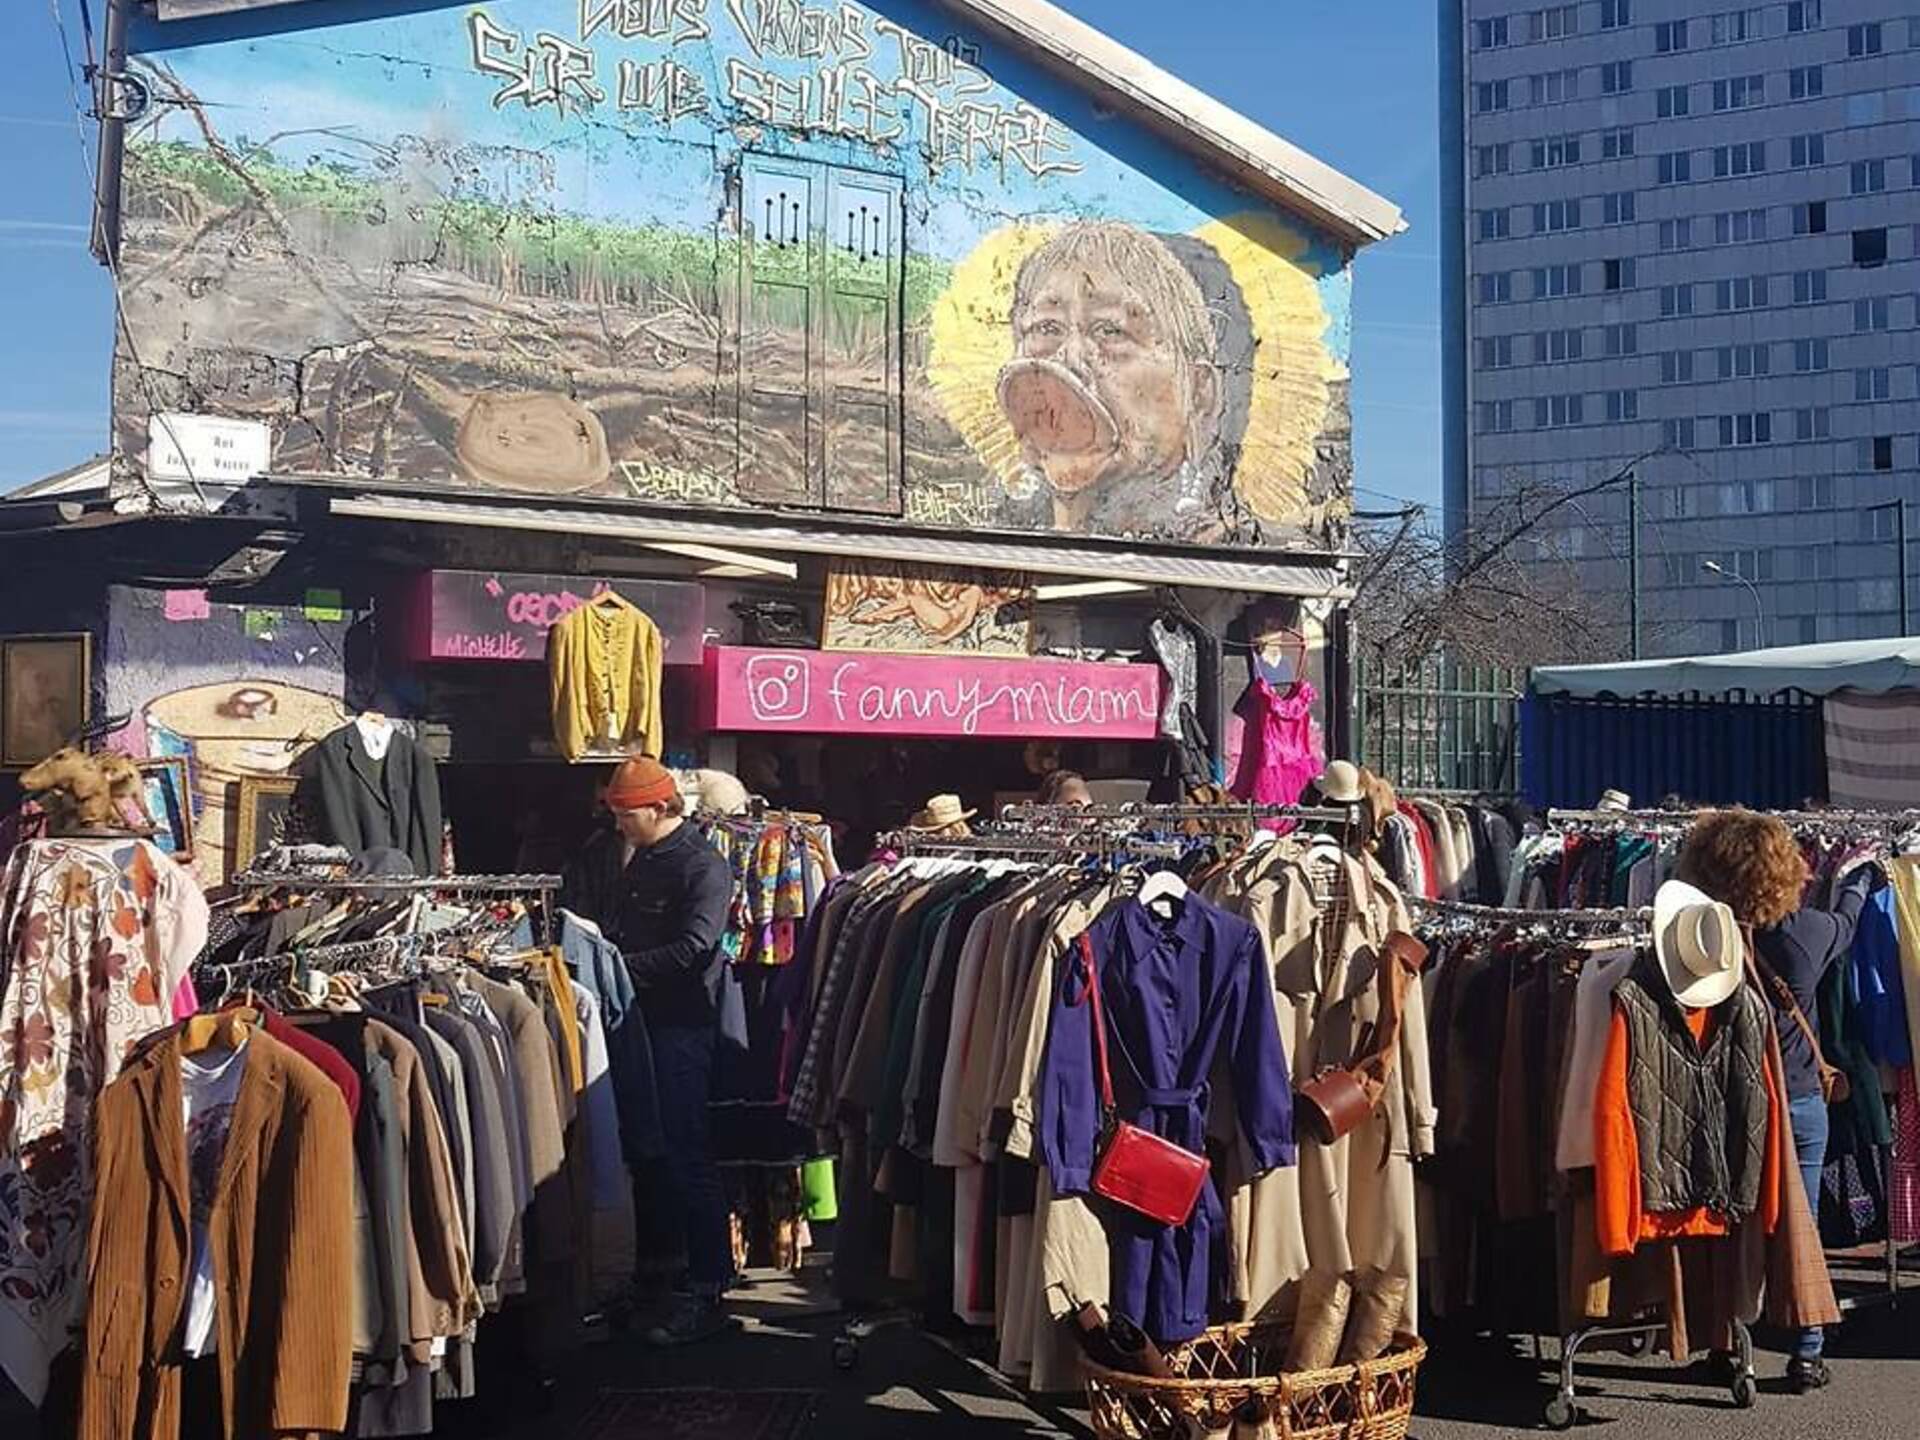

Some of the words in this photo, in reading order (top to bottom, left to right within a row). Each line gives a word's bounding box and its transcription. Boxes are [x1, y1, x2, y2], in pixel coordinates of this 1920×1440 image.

[466, 11, 605, 112] SUR
[617, 58, 710, 120] UNE
[894, 78, 1085, 177] TERRE
[873, 17, 994, 97] TOUS
